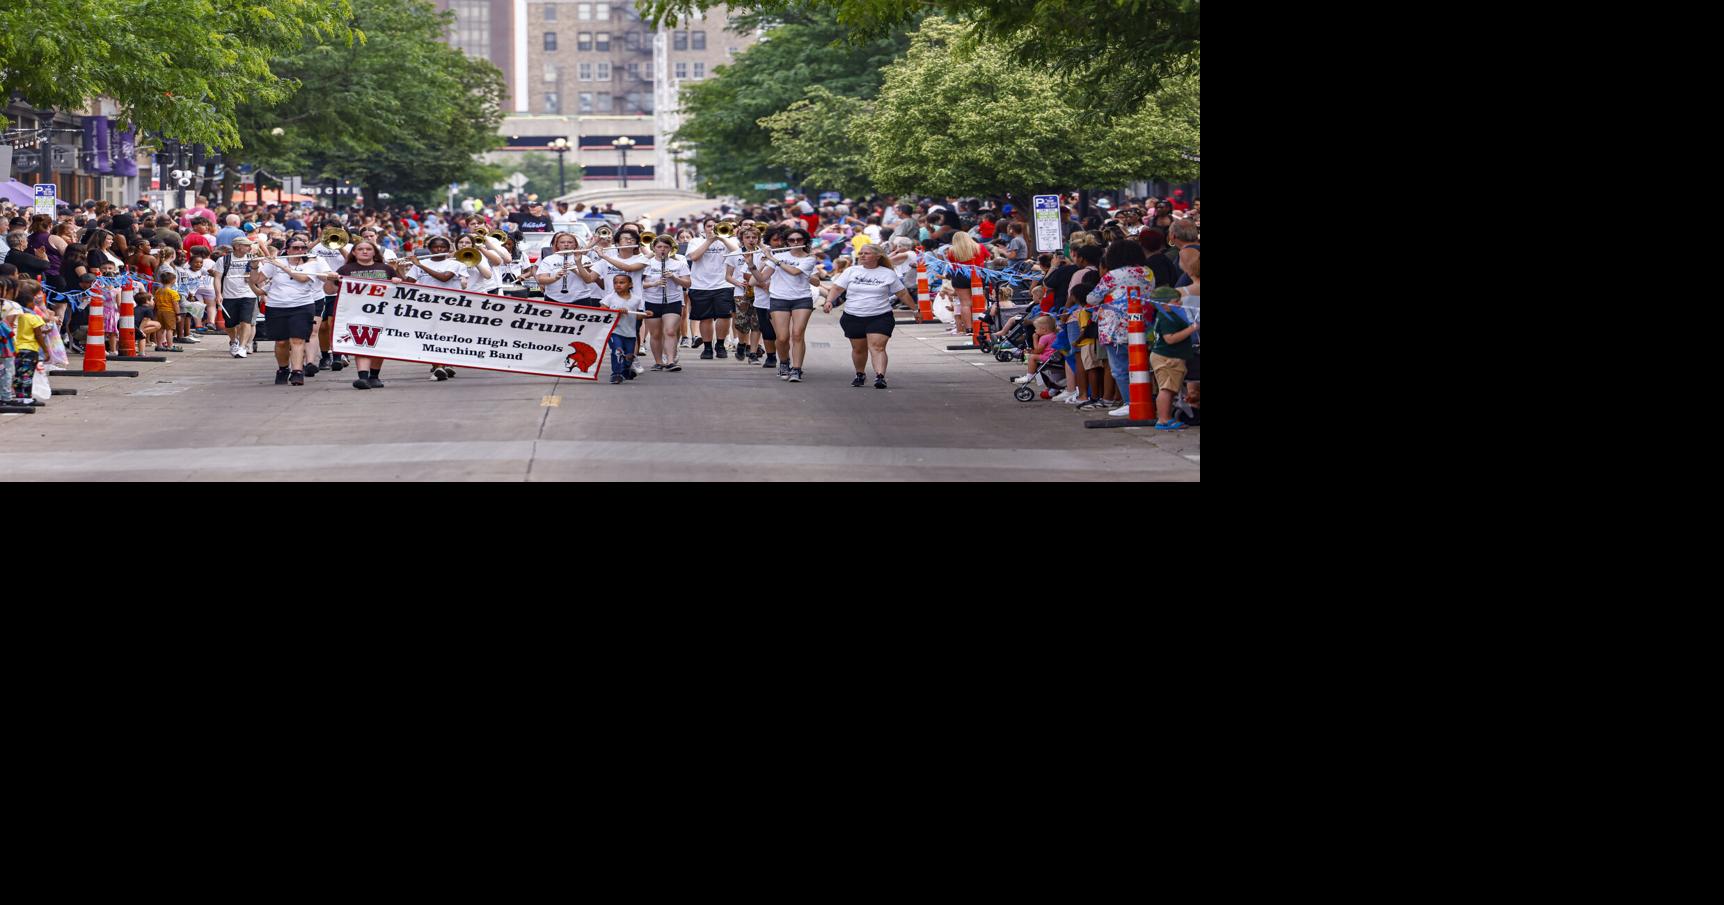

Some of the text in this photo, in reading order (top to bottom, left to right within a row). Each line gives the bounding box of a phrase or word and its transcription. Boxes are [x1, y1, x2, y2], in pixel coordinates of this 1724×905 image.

[36, 186, 43, 195] P
[1036, 198, 1044, 208] P
[345, 282, 614, 324] WE March to the beat
[361, 301, 585, 336] of the same drum!
[346, 323, 383, 348] W
[385, 328, 564, 353] The Waterloo High Schools
[422, 343, 523, 361] Marching Band
